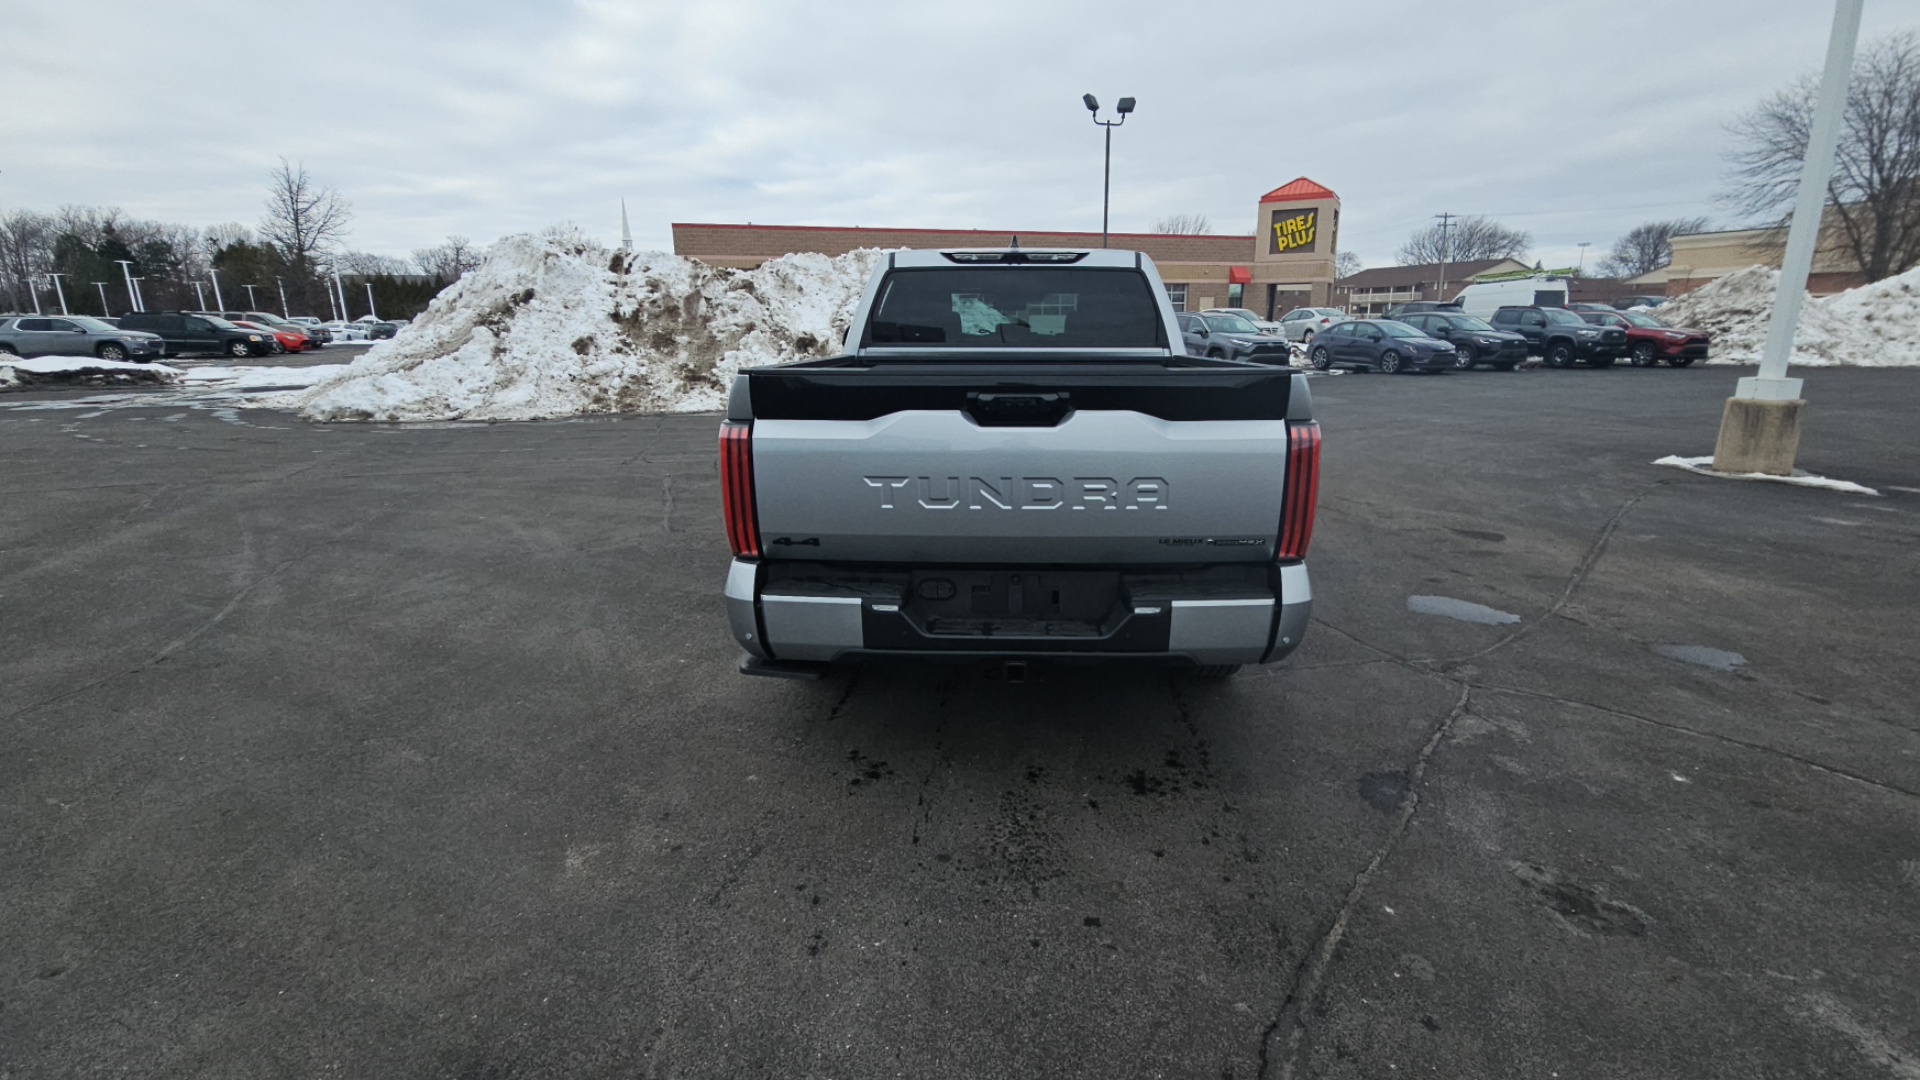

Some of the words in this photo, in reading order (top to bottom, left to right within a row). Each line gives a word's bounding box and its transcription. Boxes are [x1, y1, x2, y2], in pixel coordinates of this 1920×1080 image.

[1273, 212, 1315, 237] TIRES
[1278, 227, 1315, 252] PLUS
[863, 476, 1169, 509] TUNDRA
